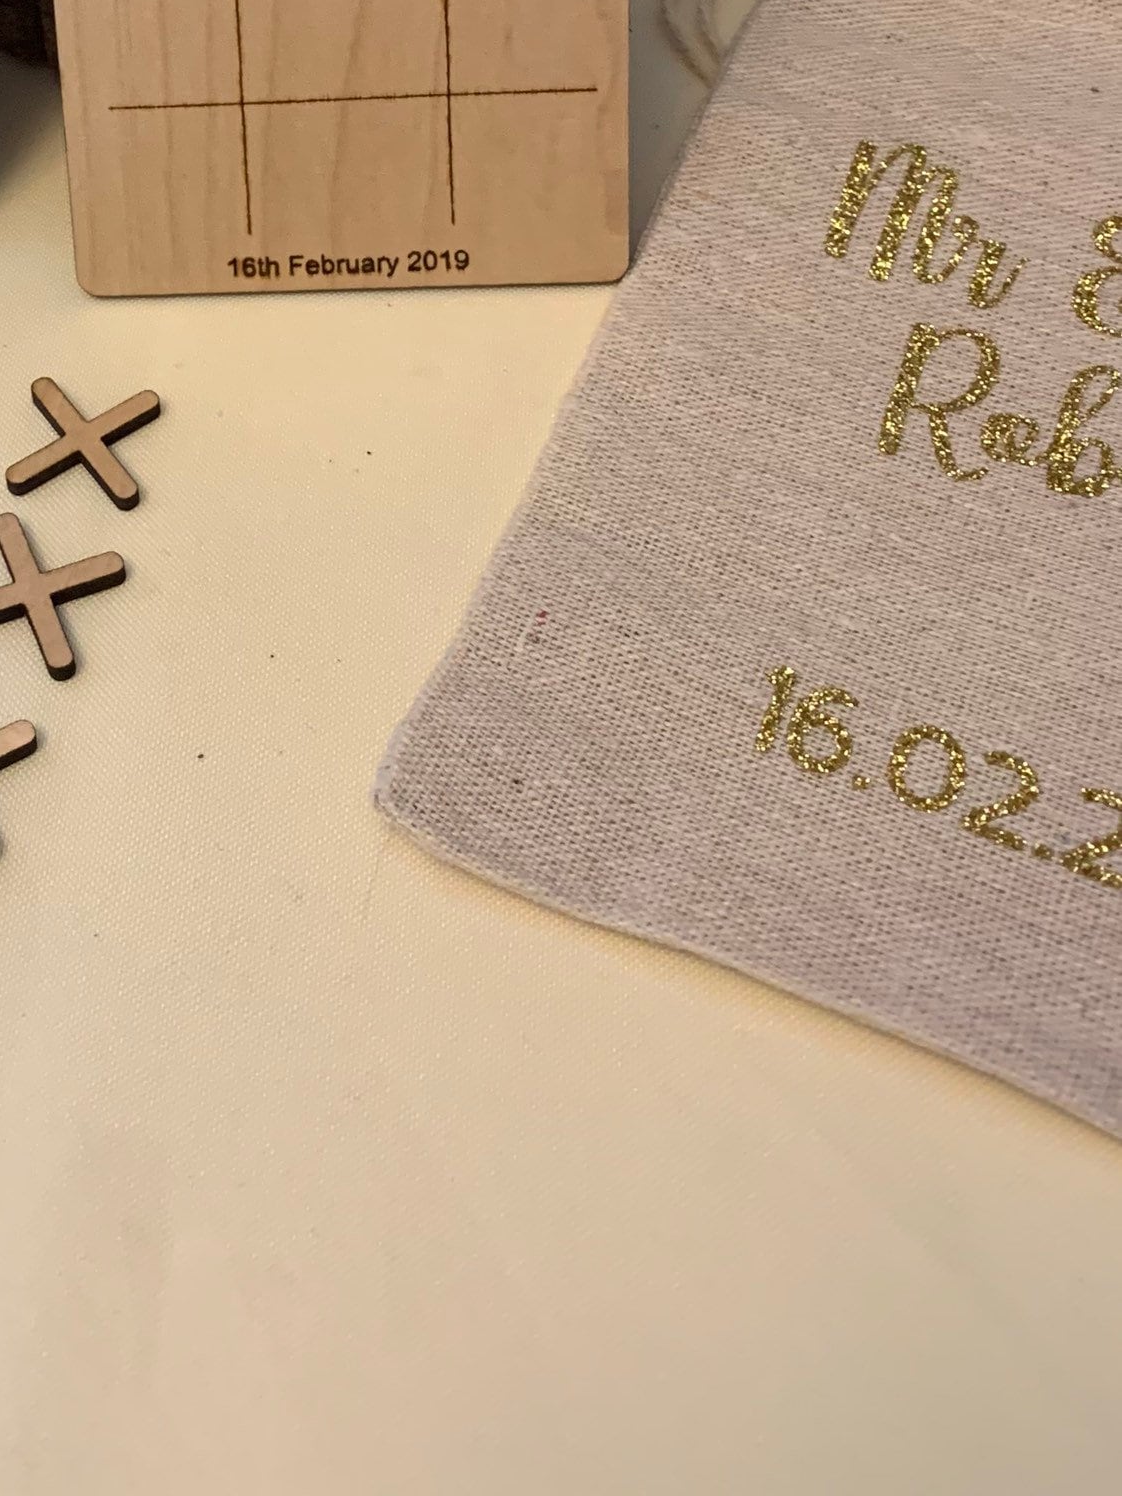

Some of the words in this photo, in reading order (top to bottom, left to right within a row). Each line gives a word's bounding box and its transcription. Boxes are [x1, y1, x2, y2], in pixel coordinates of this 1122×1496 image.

[227, 257, 279, 279] 16th
[288, 254, 399, 278] February
[407, 249, 469, 272] 2019
[824, 139, 1030, 308] Mr
